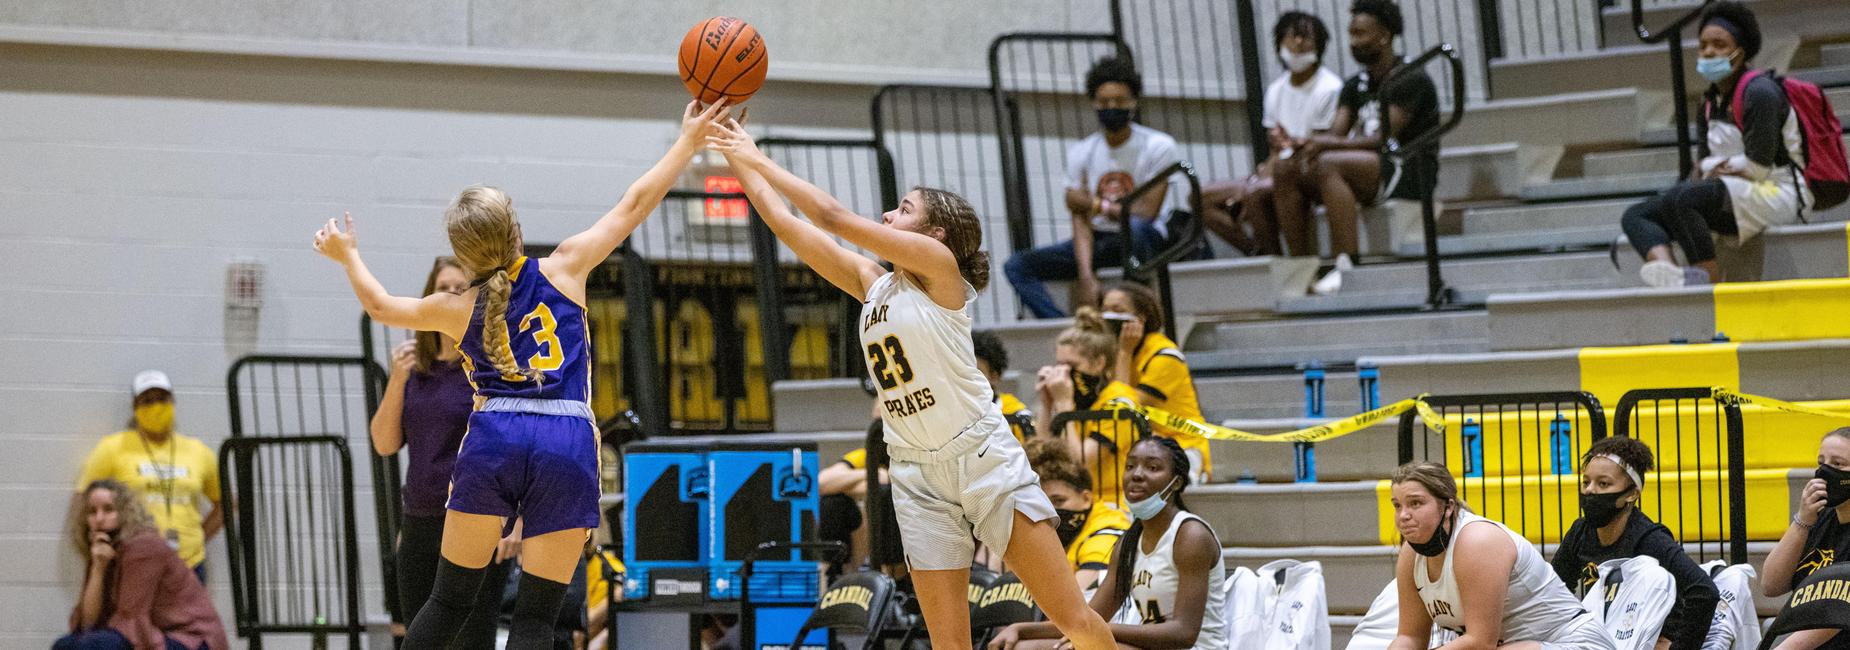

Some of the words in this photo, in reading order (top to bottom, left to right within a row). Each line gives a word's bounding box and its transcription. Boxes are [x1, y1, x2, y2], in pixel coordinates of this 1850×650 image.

[706, 16, 737, 51] Bade
[867, 334, 914, 391] 23
[884, 387, 936, 418] PRAES
[1428, 599, 1455, 618] LADY
